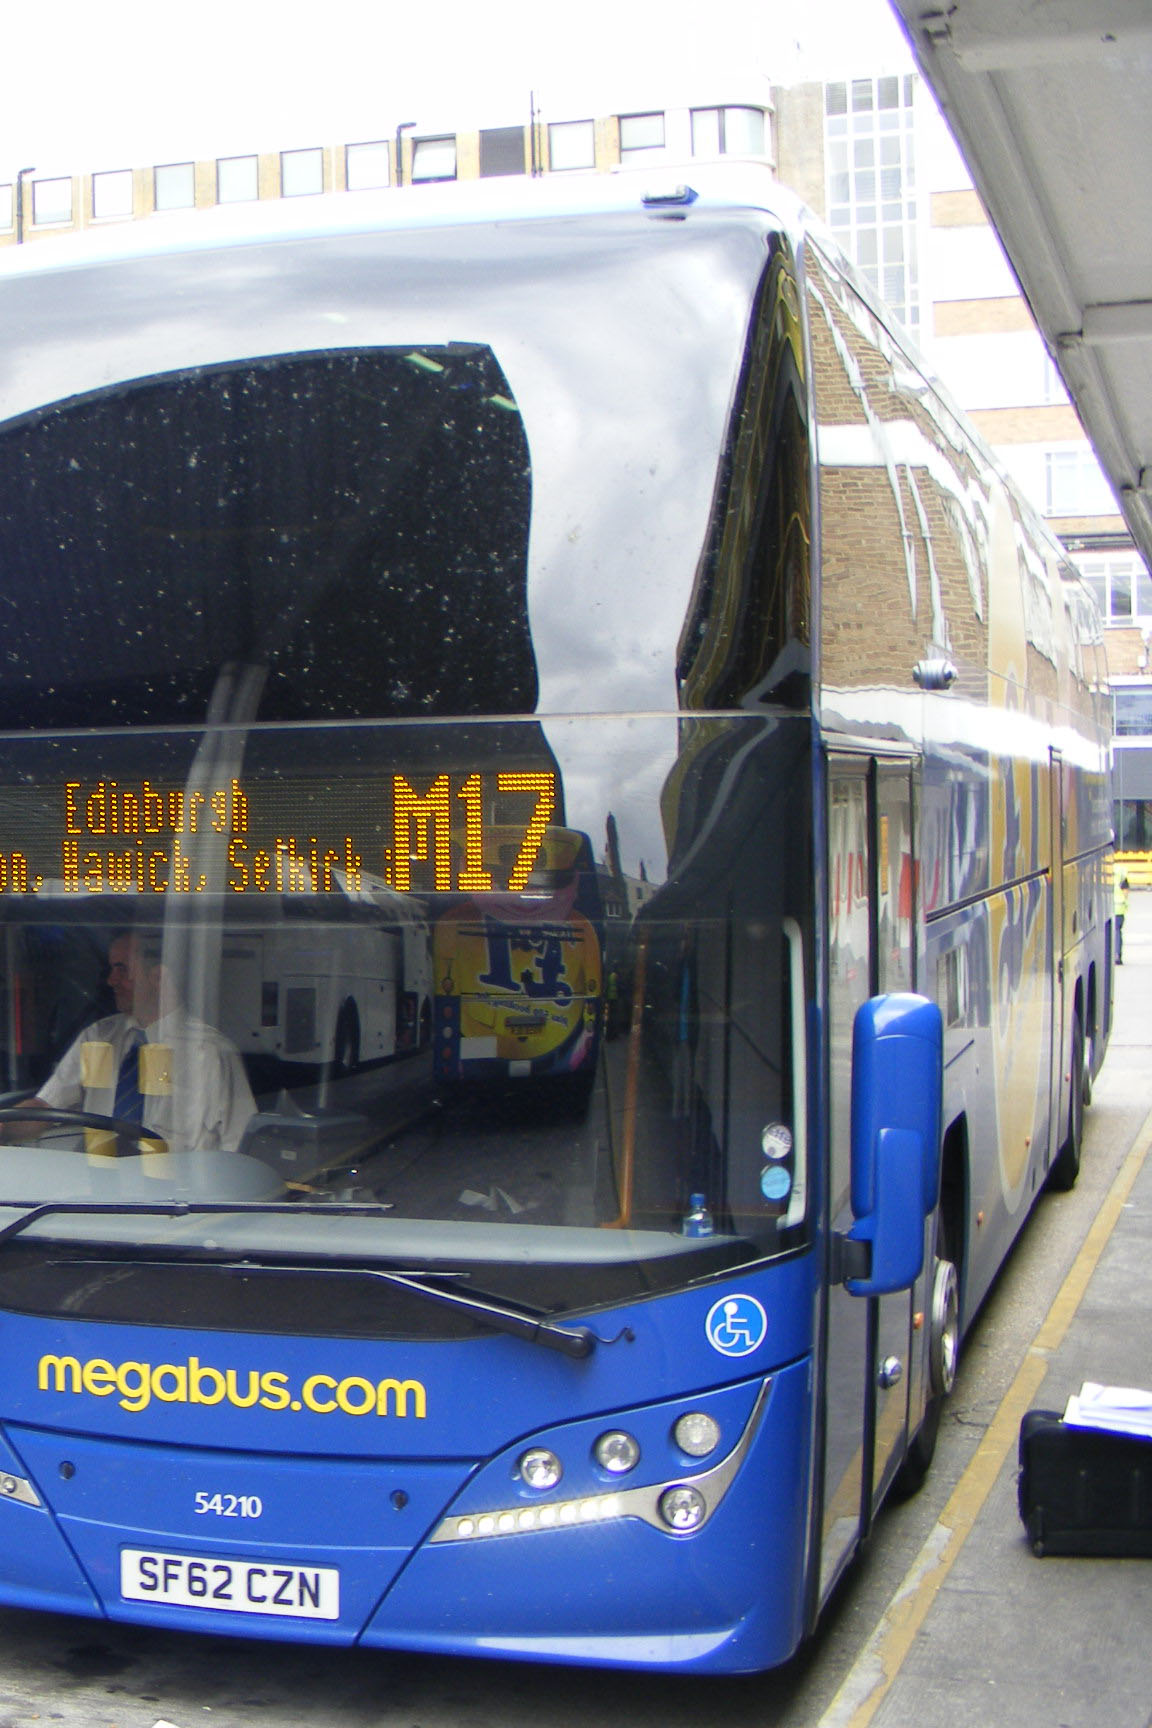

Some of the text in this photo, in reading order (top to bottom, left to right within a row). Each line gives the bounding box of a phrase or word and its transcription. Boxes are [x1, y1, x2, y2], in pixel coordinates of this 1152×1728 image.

[64, 778, 248, 834] Edinburgh
[392, 772, 555, 891] M17
[62, 839, 207, 893] Hawick,
[227, 837, 362, 892] Selkirk
[37, 1353, 428, 1419] megabus.com
[194, 1491, 264, 1519] 54210
[138, 1556, 321, 1609] SF62 CZN
